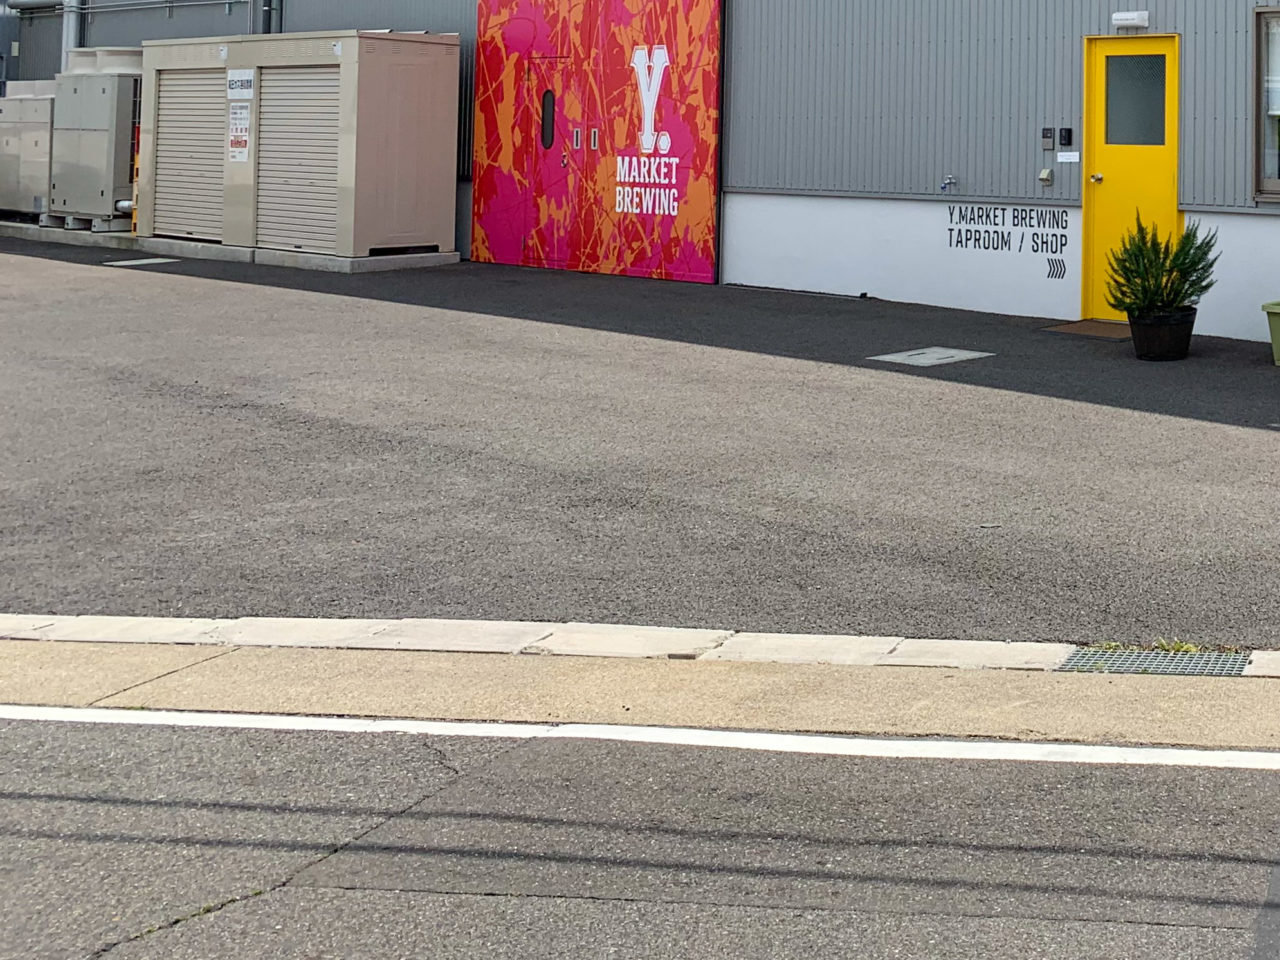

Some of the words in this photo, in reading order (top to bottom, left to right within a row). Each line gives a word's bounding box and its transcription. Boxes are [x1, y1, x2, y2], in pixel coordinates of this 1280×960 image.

[629, 44, 672, 154] Y.
[615, 156, 680, 185] MARKET
[615, 186, 679, 216] BREWING
[948, 205, 1008, 227] Y.MARKET
[1012, 208, 1069, 230] BREWING
[947, 228, 1012, 252] TAPROOM
[1018, 231, 1025, 253] /
[1031, 232, 1068, 255] SHOP
